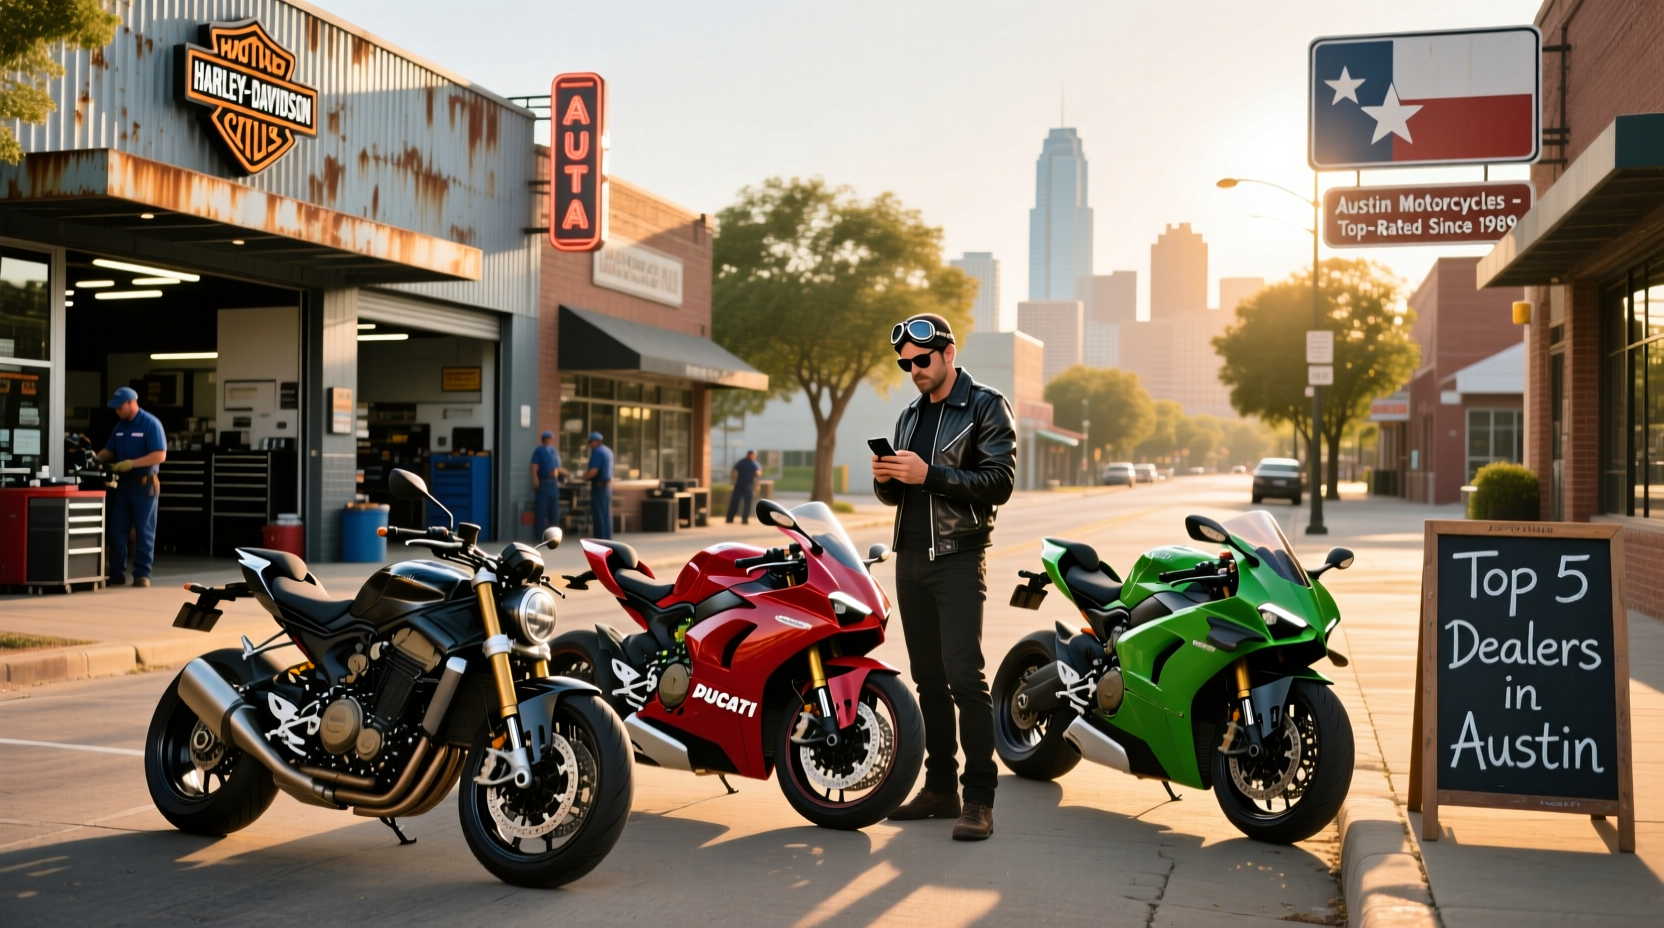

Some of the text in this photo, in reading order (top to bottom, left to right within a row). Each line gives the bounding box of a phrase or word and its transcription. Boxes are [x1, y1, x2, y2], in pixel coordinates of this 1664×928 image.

[193, 60, 311, 125] HARLEY-DAVIDSON
[562, 95, 590, 229] AUTA
[1335, 196, 1391, 215] Austin
[1399, 191, 1505, 215] Motorcycles
[1337, 214, 1518, 241] Top-Rated Since 1989
[1452, 550, 1590, 617] Top 5
[1445, 619, 1602, 670] Dealers
[692, 683, 757, 717] DUCATI
[1505, 675, 1542, 711] in
[1450, 711, 1604, 773] Austin
